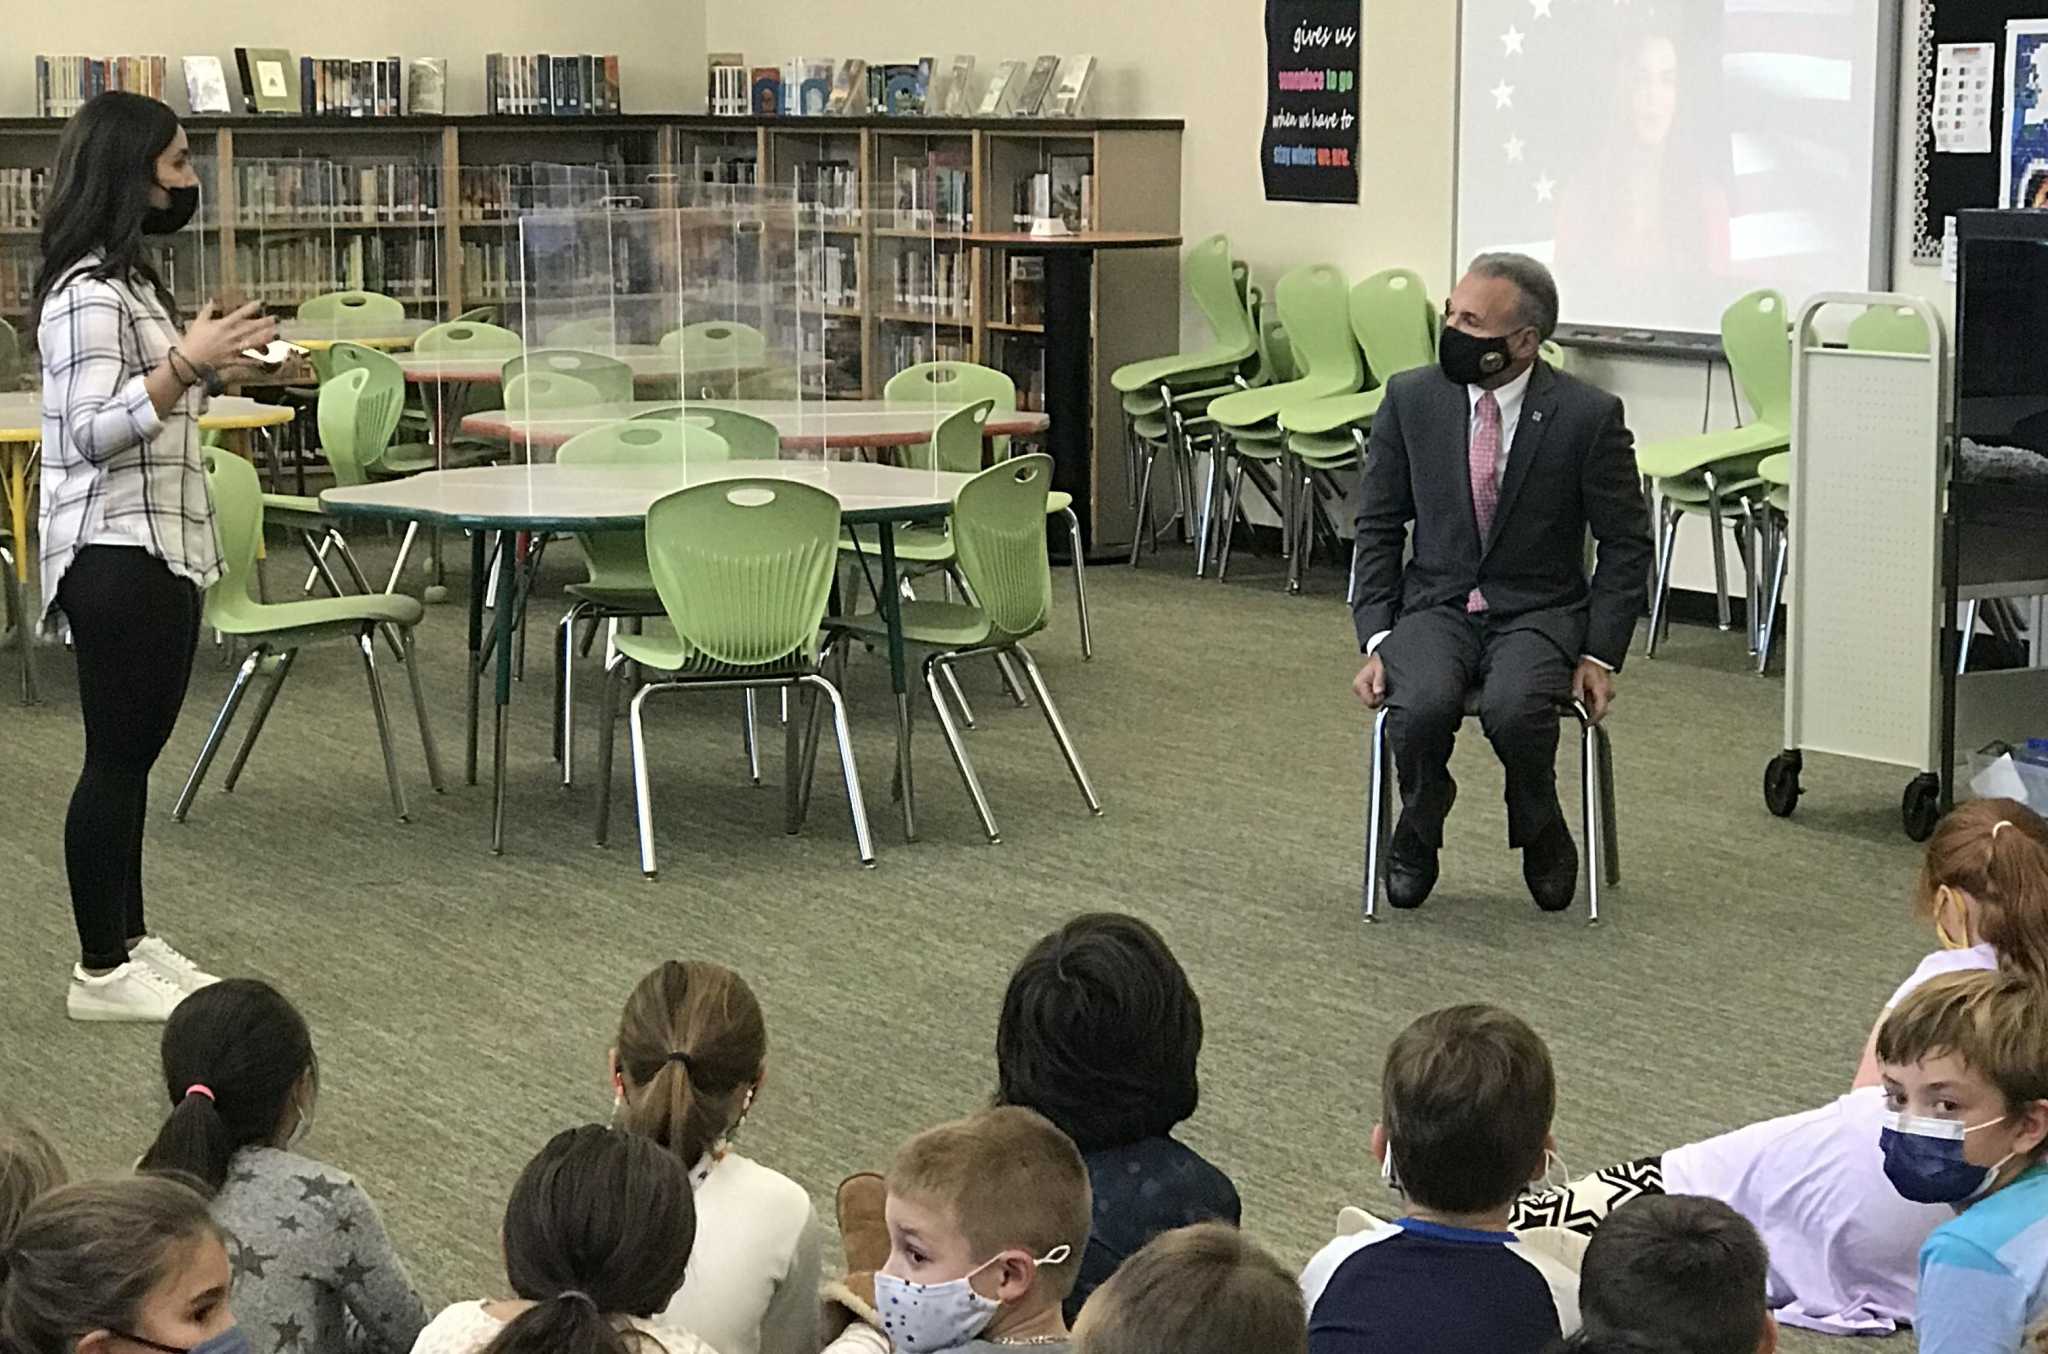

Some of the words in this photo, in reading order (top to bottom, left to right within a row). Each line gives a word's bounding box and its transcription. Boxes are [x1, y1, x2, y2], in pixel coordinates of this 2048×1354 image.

[1293, 19, 1332, 53] gives
[1335, 26, 1356, 48] us
[1272, 107, 1297, 128] when
[1298, 112, 1310, 128] we
[1311, 107, 1339, 130] have
[1341, 108, 1355, 130] to
